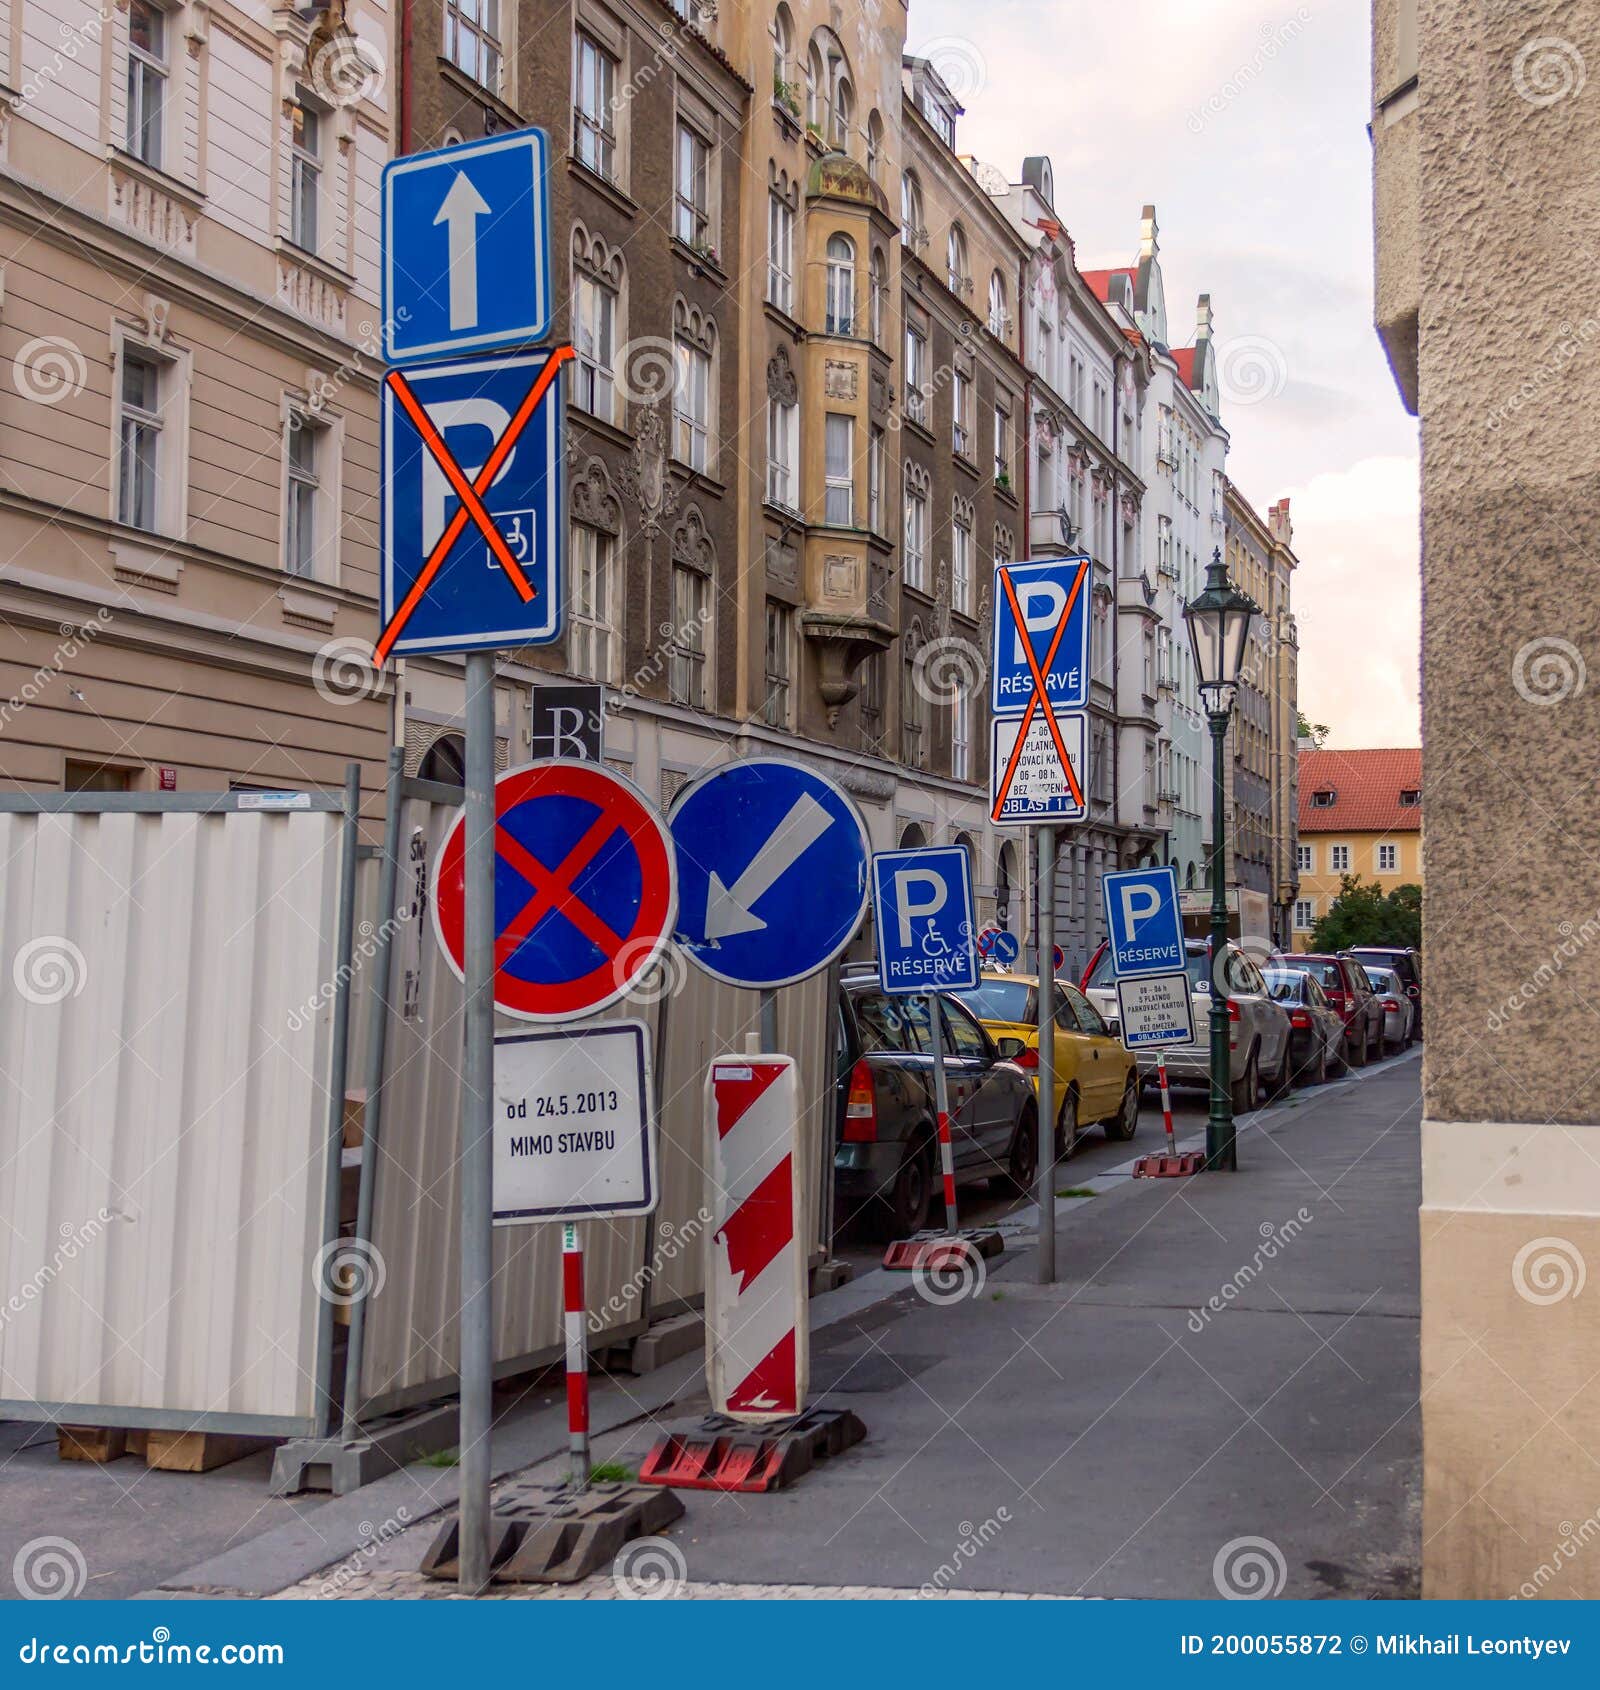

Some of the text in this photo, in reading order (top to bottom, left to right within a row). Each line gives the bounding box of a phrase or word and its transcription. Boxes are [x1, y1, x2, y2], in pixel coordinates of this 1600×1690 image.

[422, 398, 517, 558] P
[1014, 580, 1067, 664] P
[1000, 667, 1079, 694] RÉSRVÉ
[1038, 726, 1048, 736] 06
[1025, 740, 1054, 751] PLATNO
[1019, 770, 1029, 780] 06
[1038, 769, 1048, 780] 08
[1013, 784, 1028, 795] BEZ
[1057, 798, 1062, 810] 1
[894, 869, 947, 947] P
[1120, 884, 1161, 942] P
[890, 953, 966, 976] RÉSERVÉ
[1118, 944, 1178, 963] RÉSERVÉ
[506, 1090, 618, 1119] od 24.5.2013
[510, 1130, 615, 1157] MIMO STAVBU
